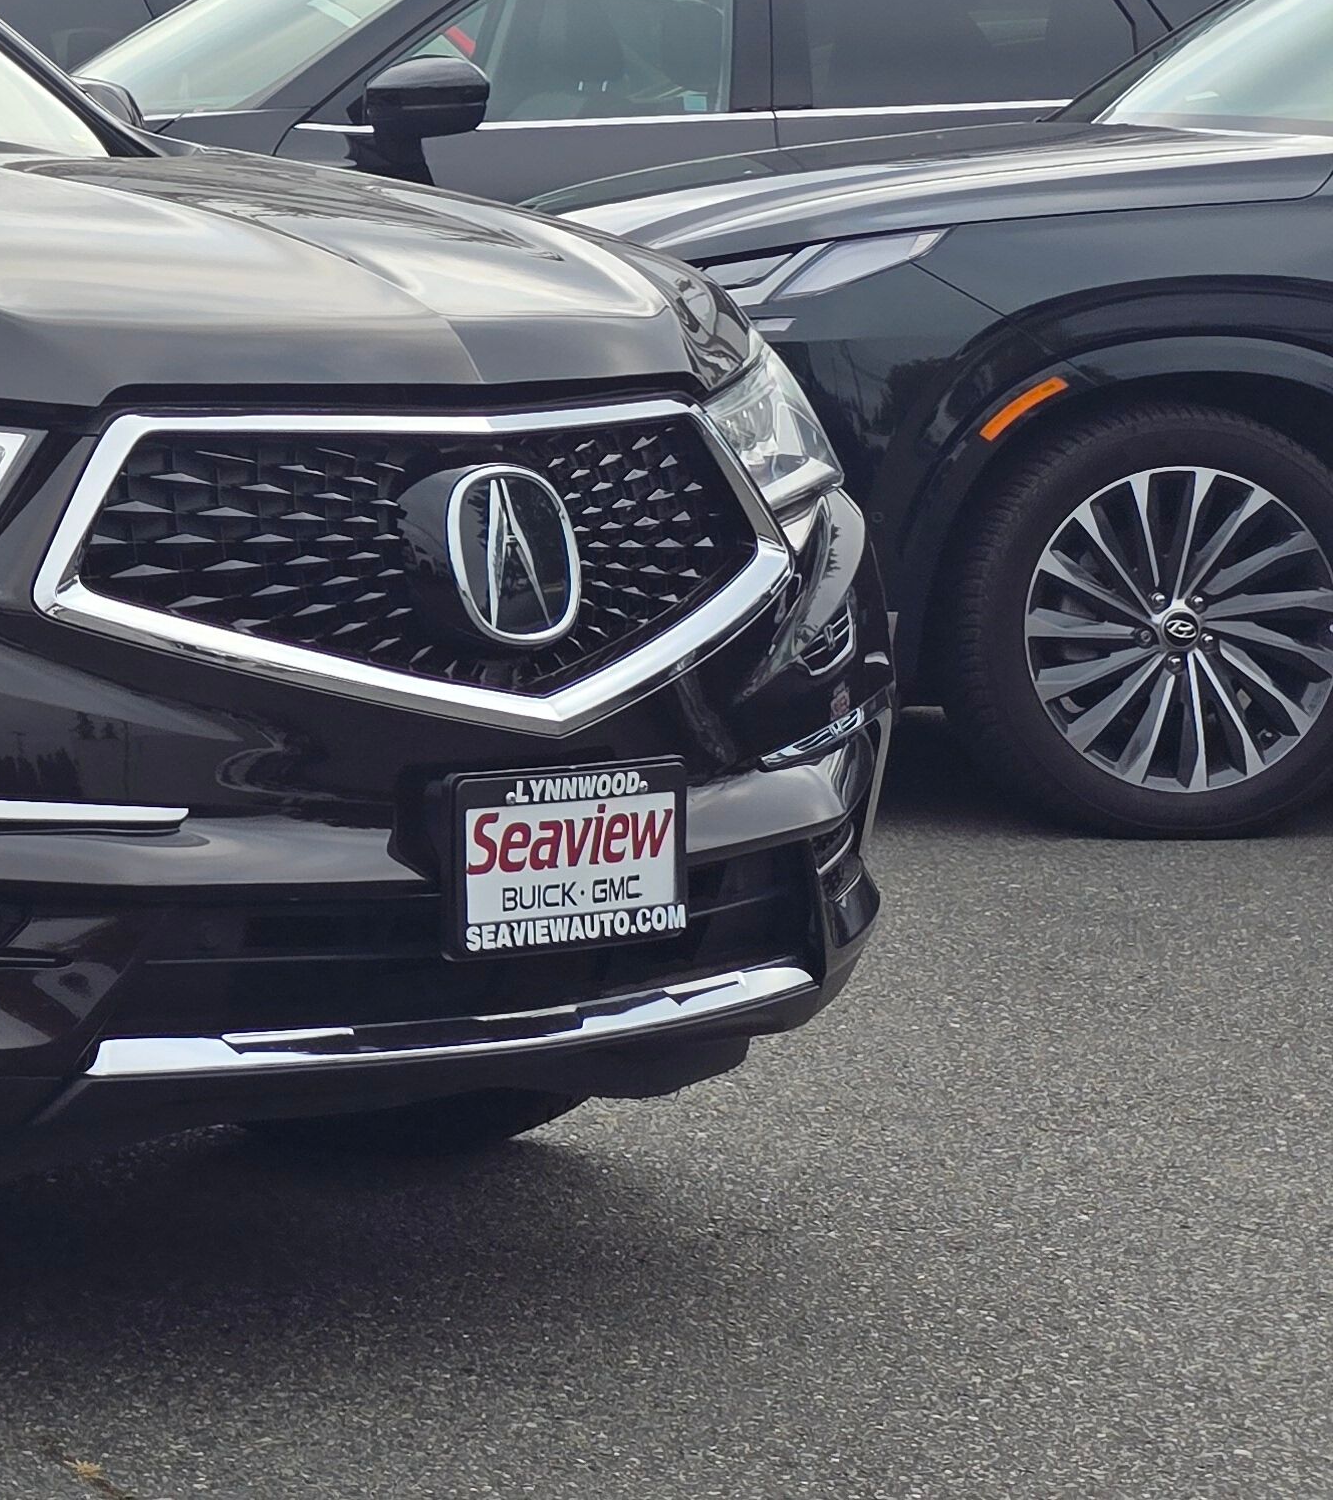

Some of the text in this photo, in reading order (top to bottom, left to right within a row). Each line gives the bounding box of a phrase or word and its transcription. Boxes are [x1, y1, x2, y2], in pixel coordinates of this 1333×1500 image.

[516, 771, 640, 802] LYNNWOOD
[466, 803, 673, 875] Seaview
[502, 874, 642, 912] BUICK GMC
[466, 904, 686, 952] SEAVIEWAUTO.COM
